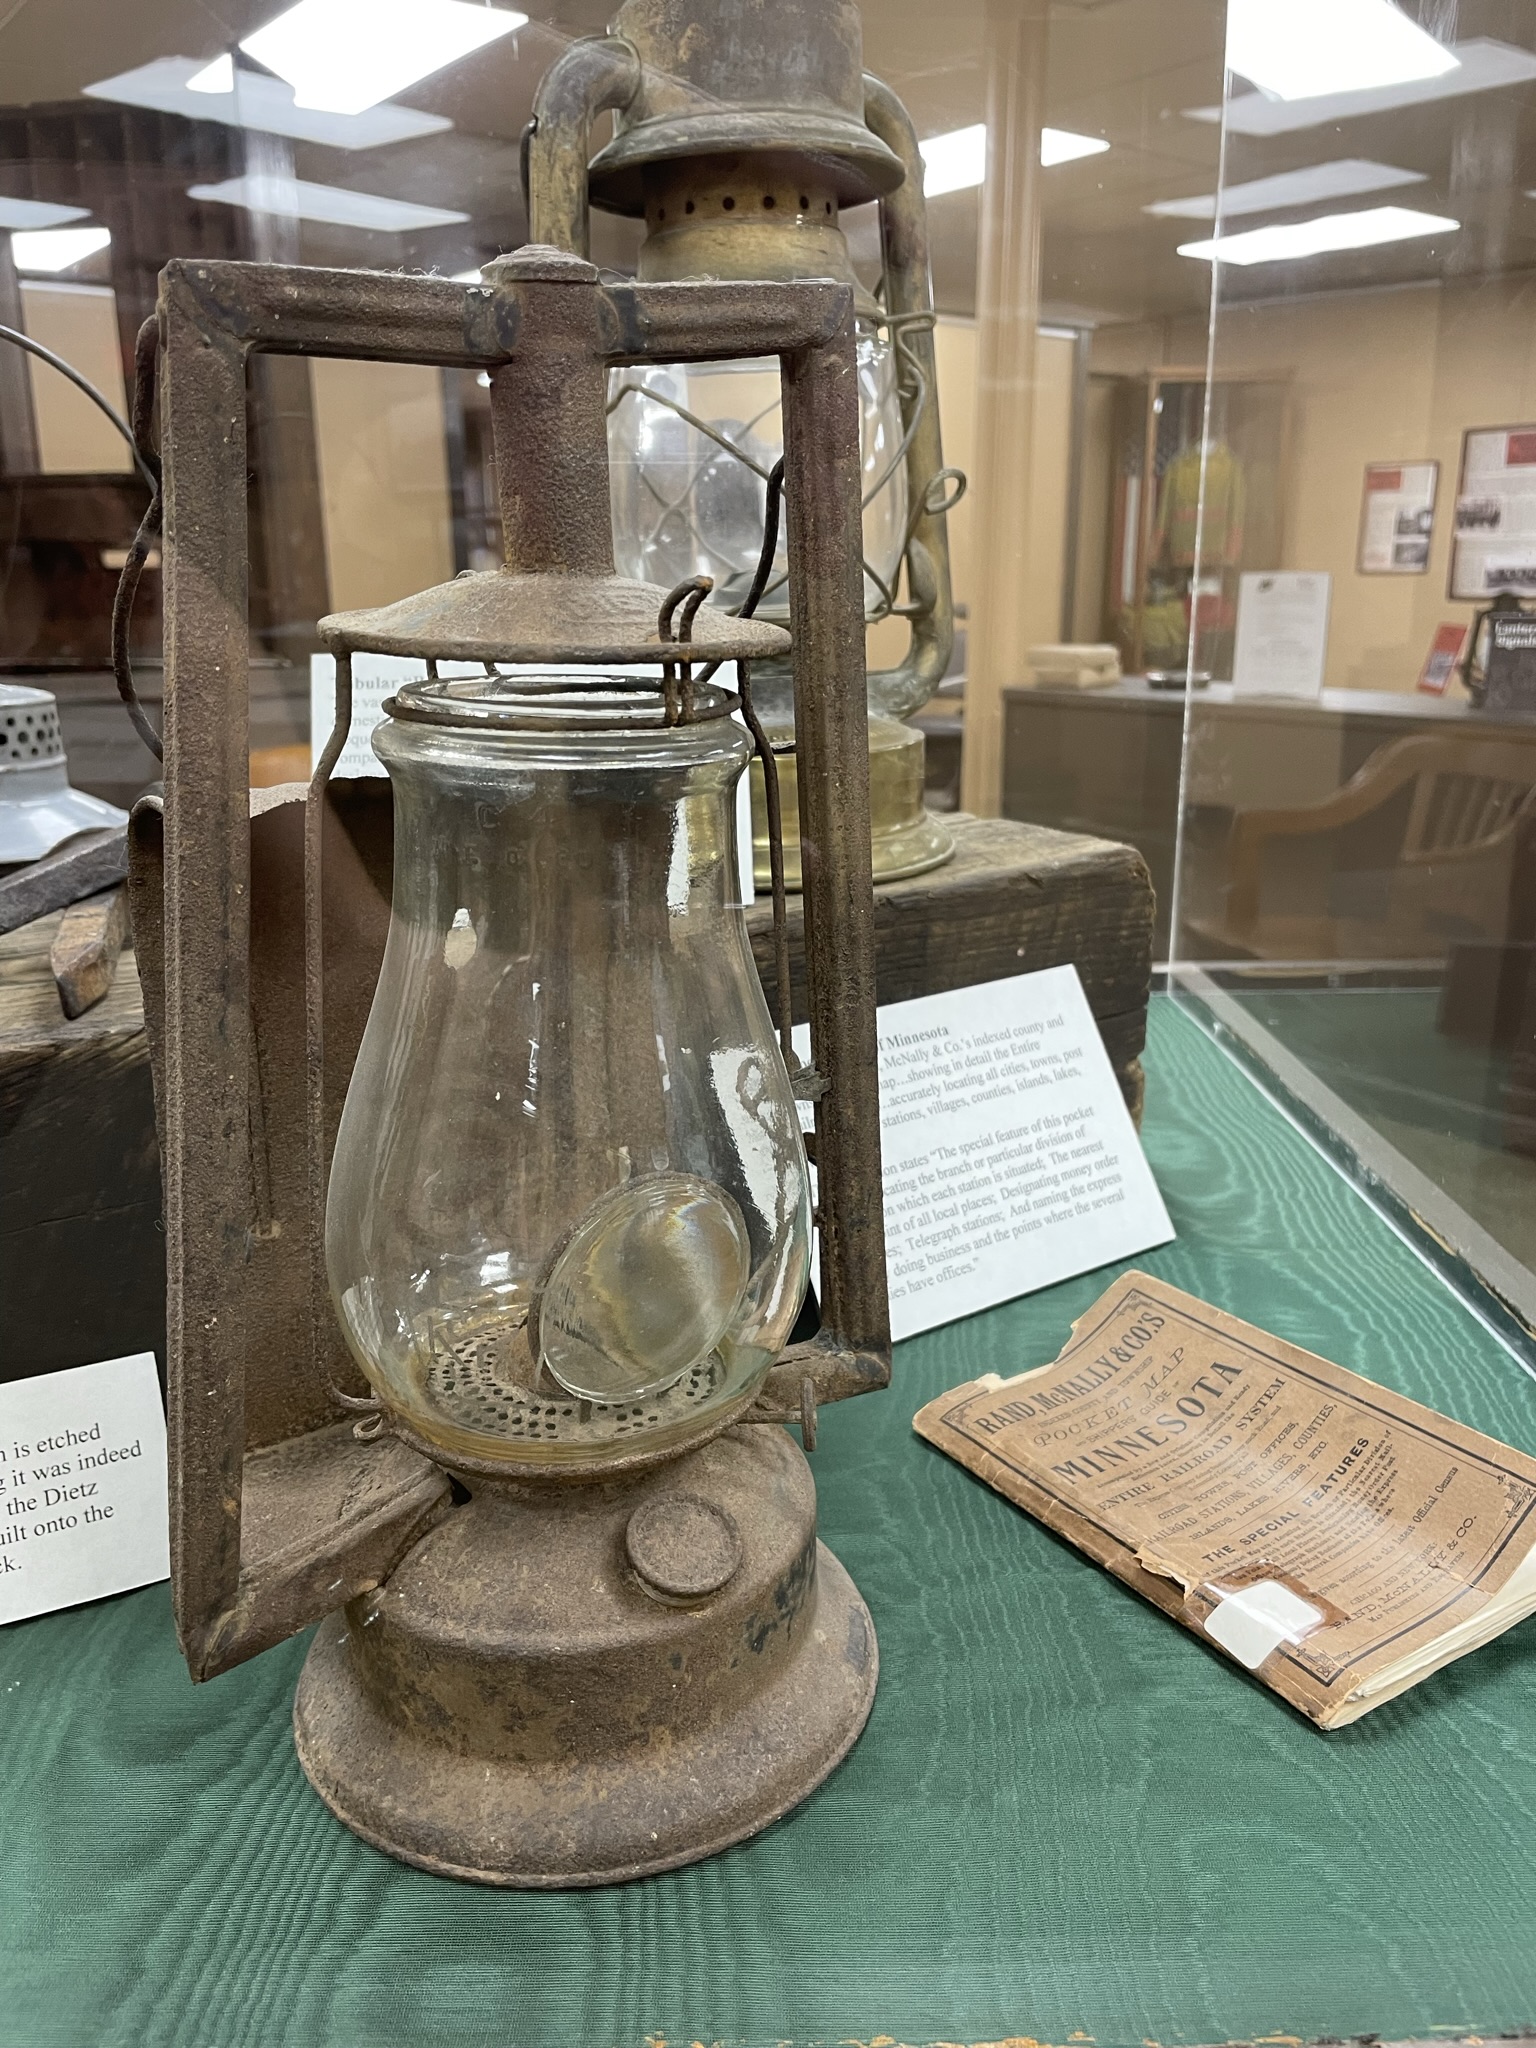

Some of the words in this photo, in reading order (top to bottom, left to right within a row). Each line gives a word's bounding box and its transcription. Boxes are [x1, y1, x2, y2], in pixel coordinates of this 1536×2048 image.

[882, 1046, 932, 1072] McNally
[929, 1044, 942, 1057] &
[971, 1026, 1011, 1047] indexed
[1011, 1019, 1046, 1040] county
[1044, 1013, 1064, 1028] and
[885, 1022, 949, 1049] Minnesota
[950, 1057, 962, 1070] in
[962, 1050, 992, 1067] detail
[992, 1045, 1009, 1059] the
[1009, 1037, 1041, 1055] Entire
[879, 1105, 925, 1129] stations,
[925, 1093, 971, 1119] villages,
[968, 1081, 1015, 1105] counties,
[1014, 1071, 1052, 1092] islands,
[1052, 1063, 1081, 1081] lakes,
[942, 1070, 986, 1095] locating
[983, 1067, 998, 1081] all
[998, 1058, 1030, 1078] cities,
[1029, 1052, 1061, 1070] towns,
[1062, 1046, 1084, 1063] post
[898, 1153, 929, 1172] states
[957, 1133, 995, 1156] special
[993, 1122, 1030, 1143] feature
[1028, 1118, 1042, 1133] of
[1041, 1112, 1062, 1129] this
[1060, 1104, 1095, 1126] pocket
[916, 1170, 935, 1186] the
[936, 1159, 972, 1180] branch
[972, 1158, 986, 1169] or
[984, 1140, 1033, 1168] particular
[1033, 1128, 1074, 1150] division
[1072, 1124, 1088, 1139] of
[894, 1191, 930, 1213] which
[929, 1183, 955, 1202] each
[955, 1172, 992, 1194] station
[991, 1169, 1002, 1183] is
[1001, 1155, 1046, 1181] situated;
[1047, 1148, 1069, 1165] The
[1068, 1139, 1104, 1159] nearest
[900, 1215, 918, 1231] of
[915, 1211, 932, 1226] all
[931, 1202, 959, 1221] local
[958, 1191, 997, 1216] places;
[998, 1170, 1061, 1203] Designating
[1059, 1162, 1094, 1184] money
[1092, 1151, 1120, 1171] order
[891, 1255, 926, 1279] doing
[925, 1239, 973, 1264] business
[972, 1232, 994, 1249] and
[992, 1226, 1010, 1242] the
[1009, 1215, 1043, 1239] points
[1042, 1205, 1074, 1225] where
[1073, 1199, 1091, 1215] the
[1090, 1188, 1125, 1209] several
[904, 1222, 961, 1254] Telegraph
[960, 1208, 1005, 1235] stations;
[1006, 1199, 1031, 1217] And
[1030, 1187, 1069, 1212] naming
[1066, 1182, 1085, 1198] the
[1085, 1171, 1124, 1195] express
[906, 1273, 935, 1292] have
[1029, 1395, 1138, 1448] POCKET
[1139, 1346, 1191, 1397] MAP
[1034, 1355, 1119, 1410] McNALLY
[1105, 1343, 1135, 1364] &
[1138, 1389, 1171, 1415] GUIDE
[13, 1441, 31, 1459] is
[36, 1422, 102, 1453] etched
[1049, 1357, 1245, 1485] MINNESOTA
[1095, 1481, 1155, 1511] ENTIRE
[1158, 1433, 1235, 1482] RAILROAD
[1232, 1376, 1287, 1431] SYSTEM
[1244, 1450, 1297, 1490] VILLAGES,
[1291, 1401, 1339, 1449] COUNTIES,
[11, 1469, 26, 1487] it
[32, 1461, 71, 1481] was
[77, 1439, 142, 1471] indeed
[6, 1497, 37, 1516] the
[44, 1482, 99, 1507] Dietz
[33, 1514, 78, 1536] onto
[83, 1505, 115, 1524] the
[1200, 1544, 1236, 1563] THE
[1238, 1509, 1300, 1546] SPECIAL
[1301, 1436, 1371, 1507] FEATURES
[1410, 1494, 1439, 1523] Official
[1431, 1466, 1460, 1494] Census
[1348, 1584, 1383, 1605] CHICAGO
